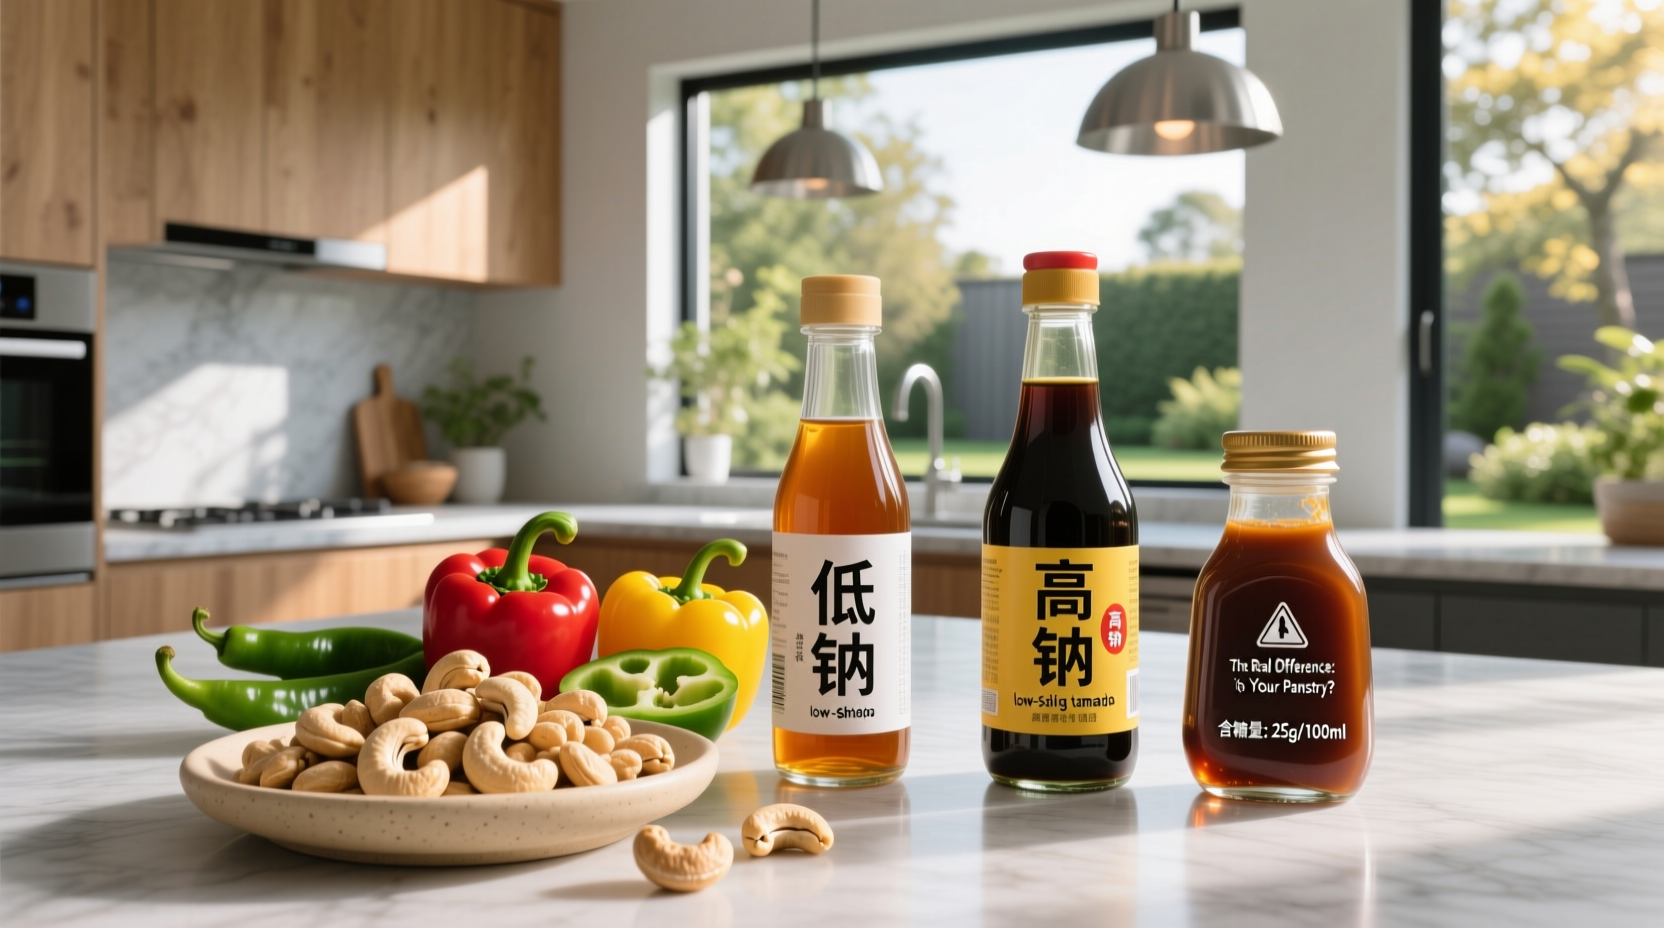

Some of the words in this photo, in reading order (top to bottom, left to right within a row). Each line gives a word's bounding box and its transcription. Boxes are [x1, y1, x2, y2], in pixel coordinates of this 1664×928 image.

[811, 559, 875, 696] 低钠
[1032, 559, 1093, 687] 高钠
[1249, 677, 1280, 693] Your
[1271, 722, 1347, 743] 25g/100ml
